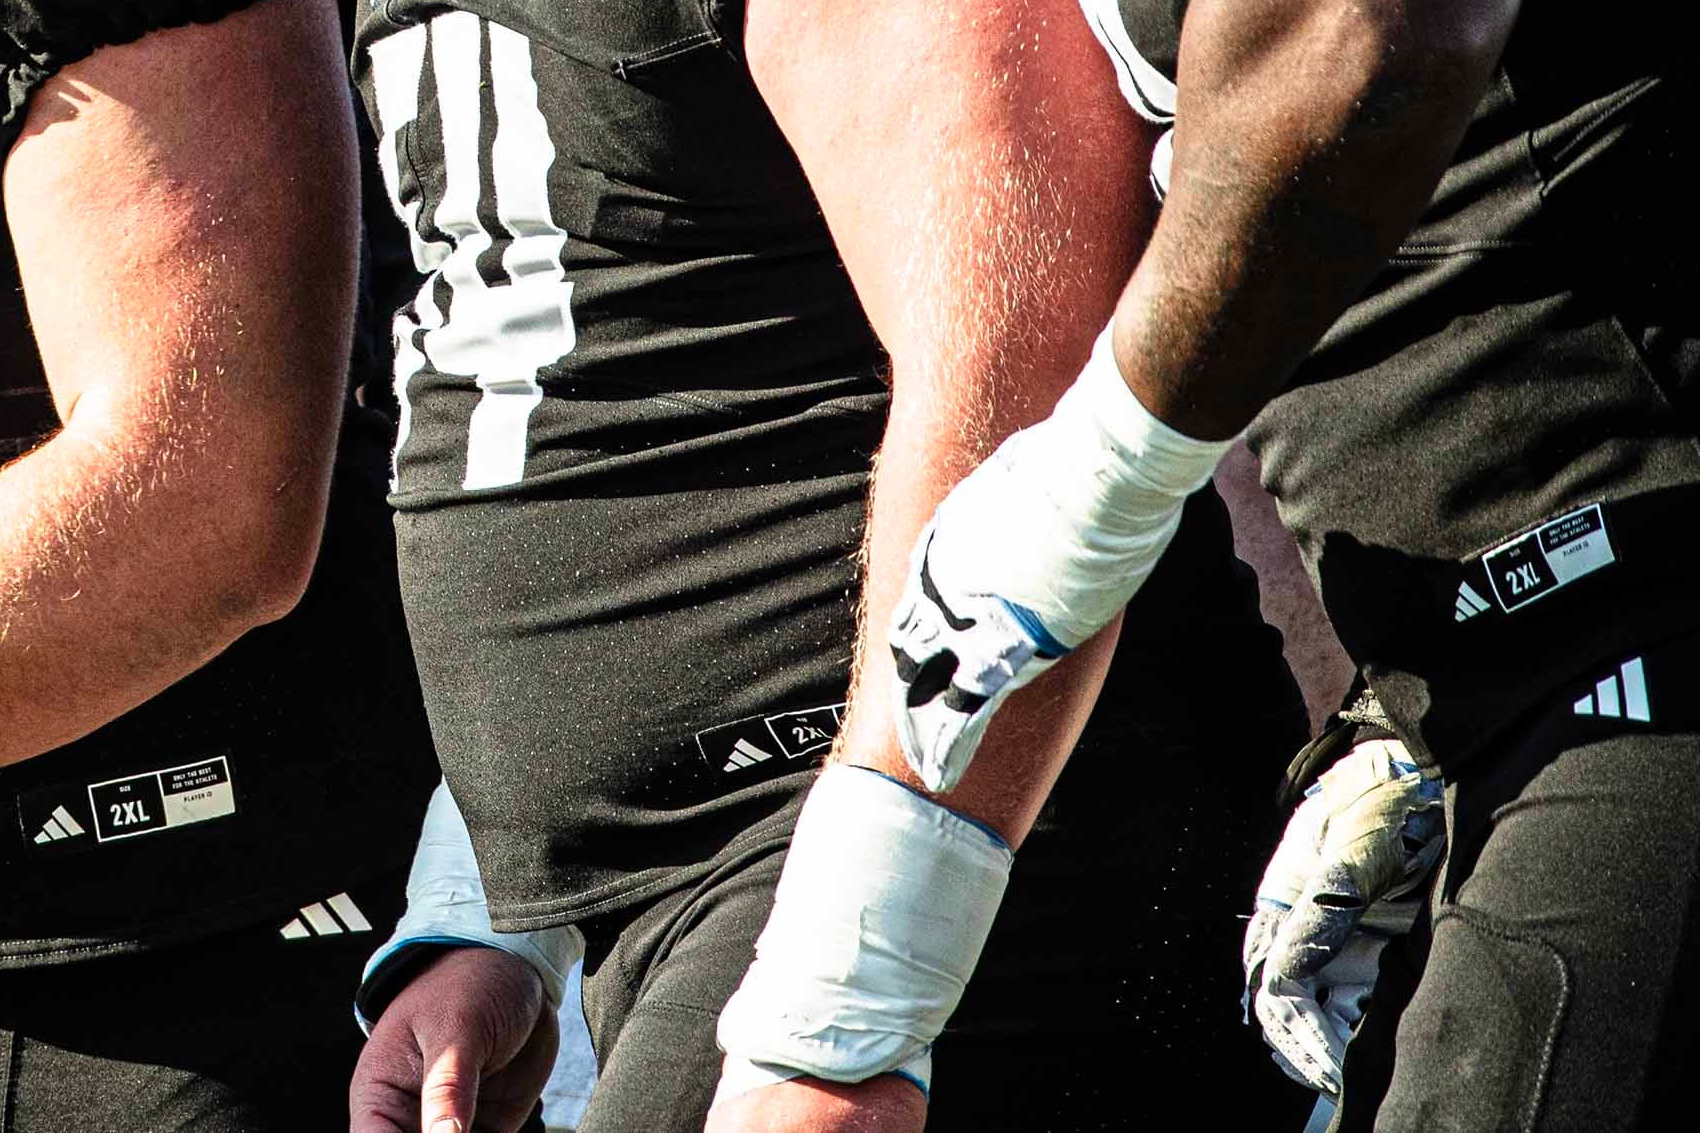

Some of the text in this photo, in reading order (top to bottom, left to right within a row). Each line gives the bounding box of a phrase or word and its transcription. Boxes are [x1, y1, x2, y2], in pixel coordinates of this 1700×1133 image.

[1505, 561, 1541, 595] 2XL
[172, 766, 212, 782] ONLY THE BEST
[172, 781, 183, 790] FOR
[184, 779, 195, 787] THE
[183, 792, 206, 803] PLAYER
[109, 800, 150, 827] 2XL
